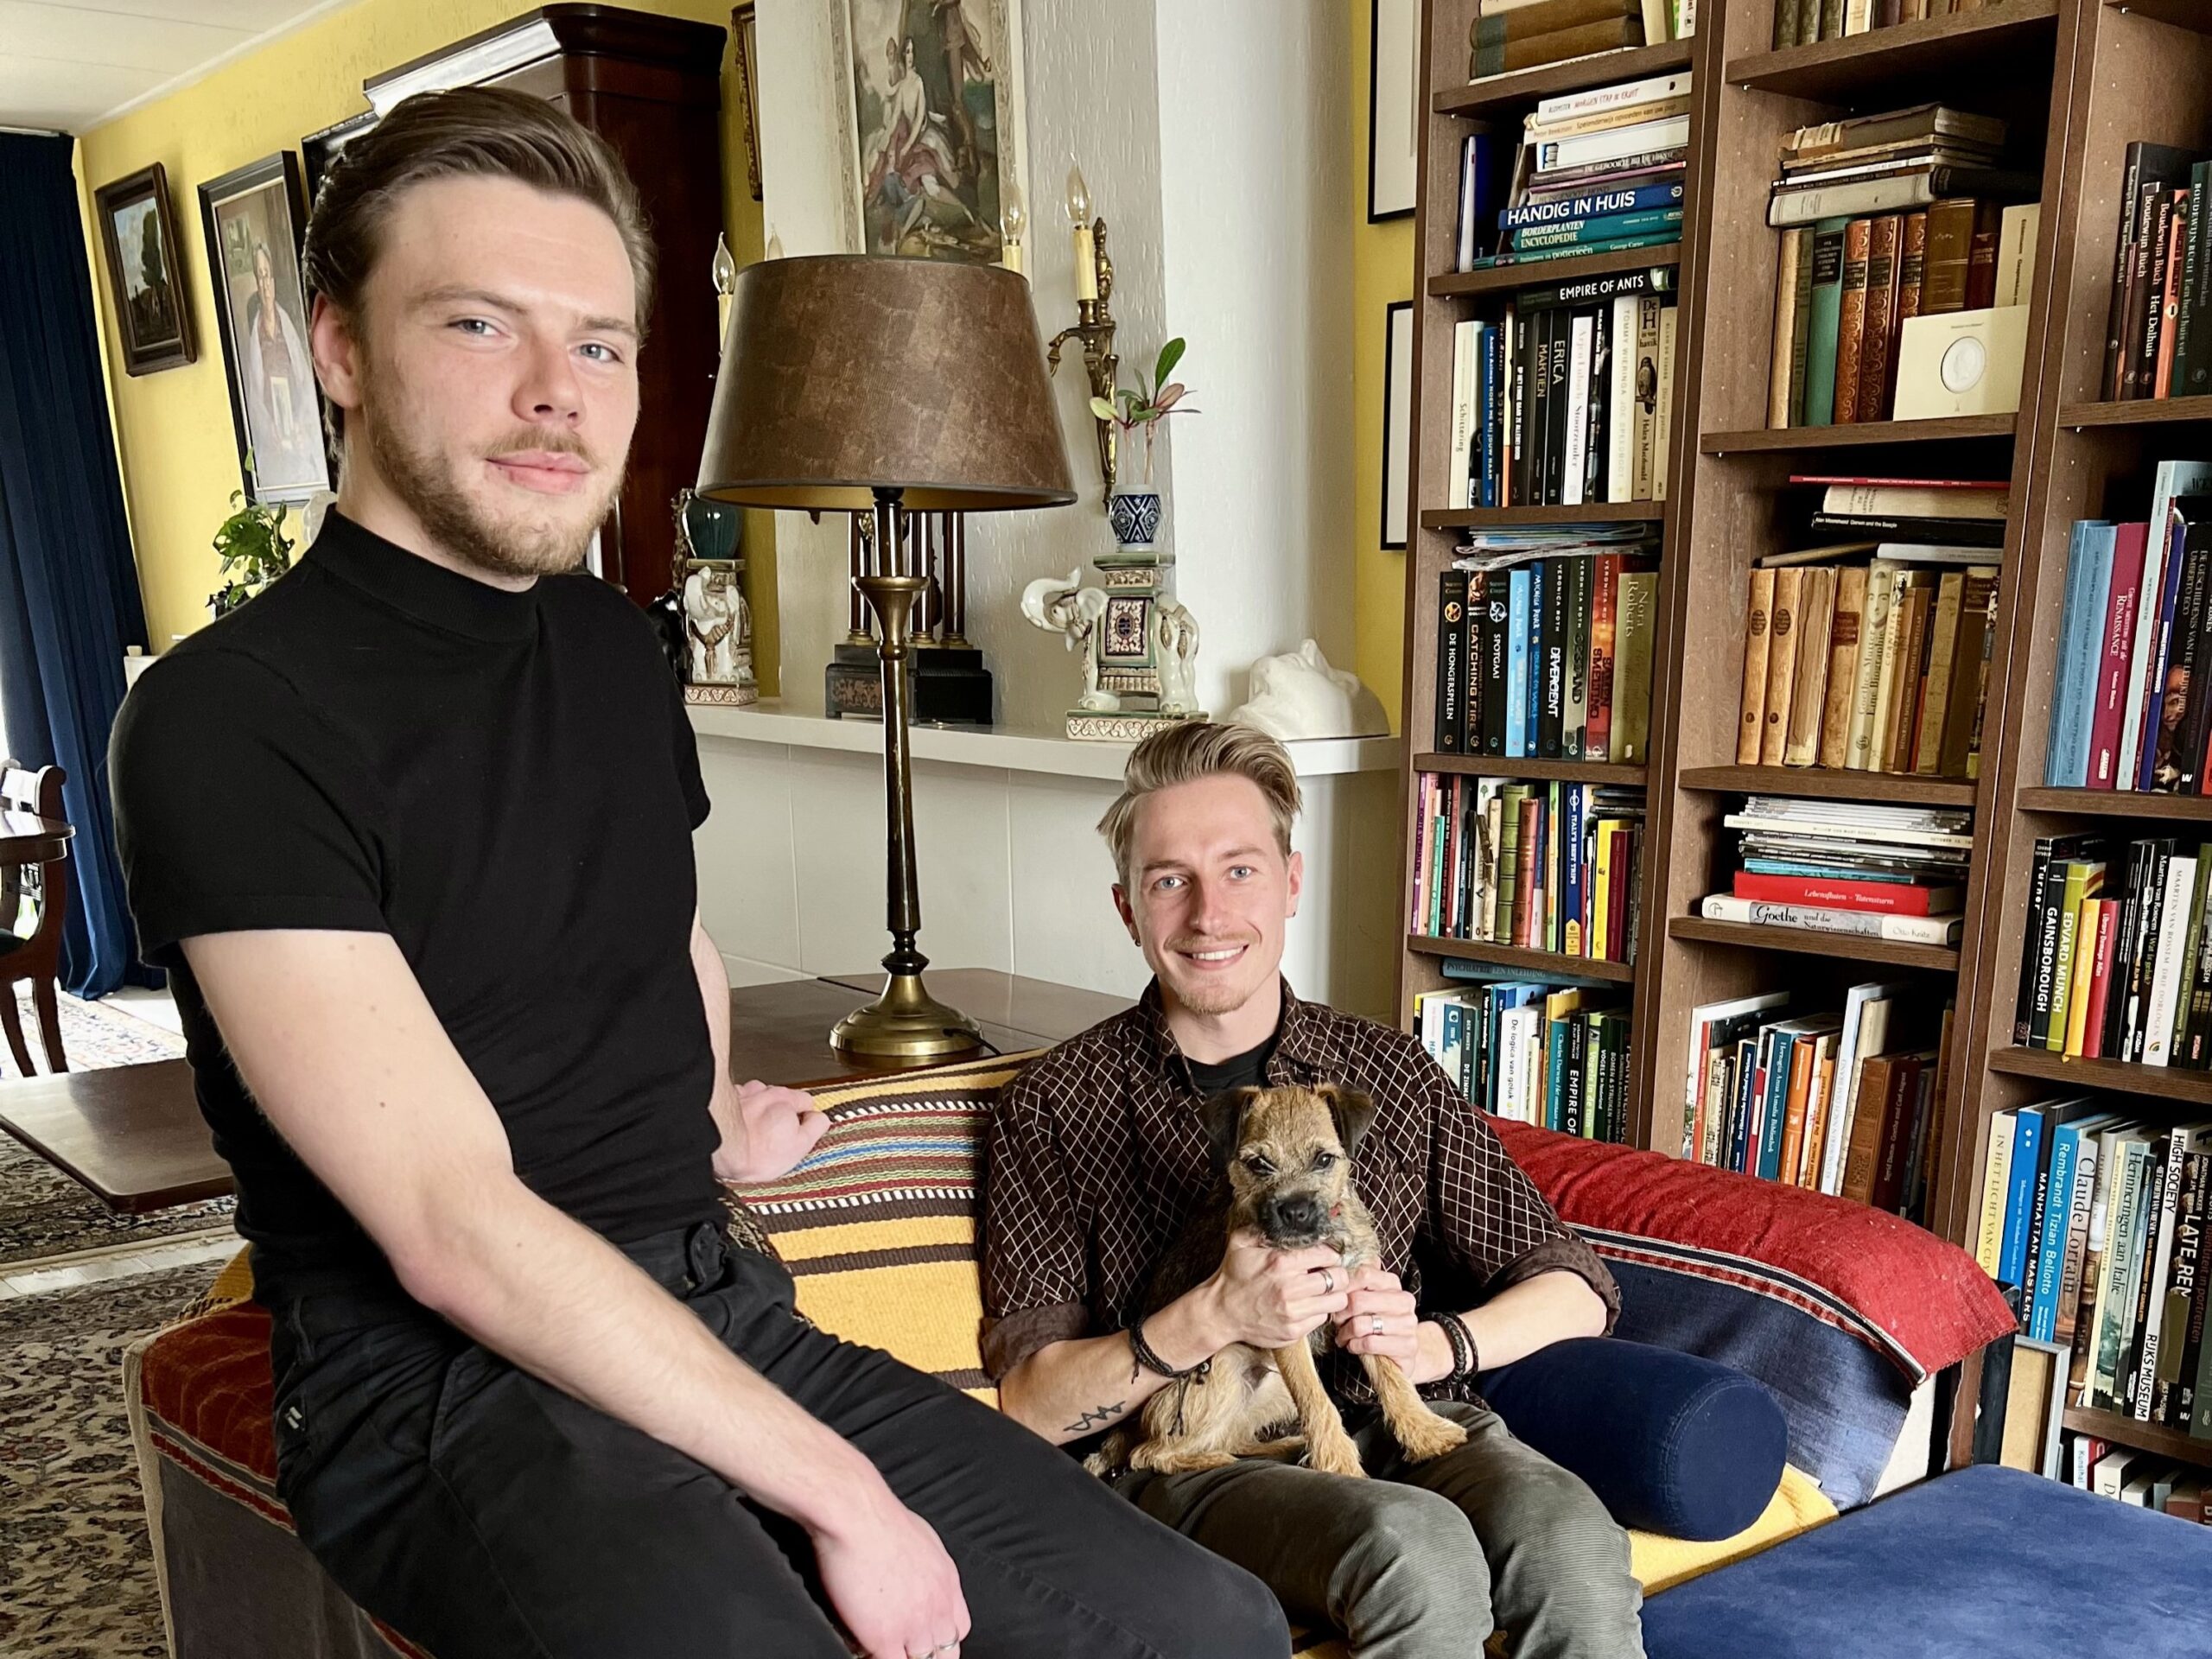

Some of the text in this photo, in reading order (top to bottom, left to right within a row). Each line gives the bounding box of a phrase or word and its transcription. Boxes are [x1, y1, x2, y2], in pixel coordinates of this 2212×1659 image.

[1508, 191, 1636, 226] HANDIG IN HUIS
[1521, 220, 1586, 238] BORDERPLANTEN
[2189, 182, 2202, 244] BOUDEWIJN
[1521, 232, 1578, 248] ENCYCLOPEDIE
[2137, 195, 2154, 277] Boudewijn Büch
[1560, 283, 1598, 301] EMPIRE
[1600, 281, 1614, 294] OF
[1617, 276, 1643, 290] ANTS
[2145, 202, 2170, 358] Boudewijn Büch Het Dolhuis
[2183, 278, 2194, 297] Een
[2178, 321, 2189, 340] huis
[1536, 344, 1548, 397] MARTIEN
[1553, 340, 1566, 385] ERICA
[1620, 348, 1629, 395] WIERINGA
[2182, 550, 2198, 615] UMBERTO ECO
[1624, 581, 1638, 637] Roberts
[1637, 591, 1649, 626] Nora
[2110, 594, 2127, 656] RENAISSANCE
[1470, 624, 1479, 696] CATCHING
[2186, 630, 2197, 652] VAN
[1446, 633, 1457, 720] DE HONGERSPELEN
[1548, 647, 1560, 718] DIVERGENT
[1866, 630, 1885, 715] Eine Biographie
[2034, 865, 2047, 910] Turner
[2156, 855, 2167, 887] Maarten
[1756, 905, 1798, 925] Goethe
[2100, 913, 2108, 935] Library
[2151, 901, 2161, 931] Rossem
[2036, 906, 2057, 1012] GAINSBOROUGH
[2052, 912, 2074, 1013] EDVARD MUNCH
[2095, 936, 2106, 960] Damage
[2148, 938, 2157, 953] Wat
[1509, 1033, 1517, 1058] logica
[1511, 1020, 1518, 1031] De
[1464, 1064, 1470, 1073] DE
[1587, 1051, 1597, 1082] Vogels
[1587, 1084, 1595, 1092] in
[1567, 1070, 1579, 1135] EMPIRE OF
[1586, 1095, 1594, 1106] de
[1986, 1135, 2006, 1246] IN HET LICHT VAN
[2052, 1142, 2069, 1208] Rembrandt
[2115, 1151, 2143, 1239] Herinneringen
[2164, 1135, 2185, 1214] HIGH SOCIETY
[2023, 1173, 2047, 1322] MANHATTAN MASTERS
[2047, 1212, 2062, 1246] Tizian
[2063, 1157, 2095, 1294] Claude Lorrain
[2179, 1214, 2199, 1258] LATE
[2041, 1249, 2056, 1295] Bellotto
[2116, 1241, 2129, 1263] aan
[2136, 1333, 2158, 1419] RIJKS MUSEUM
